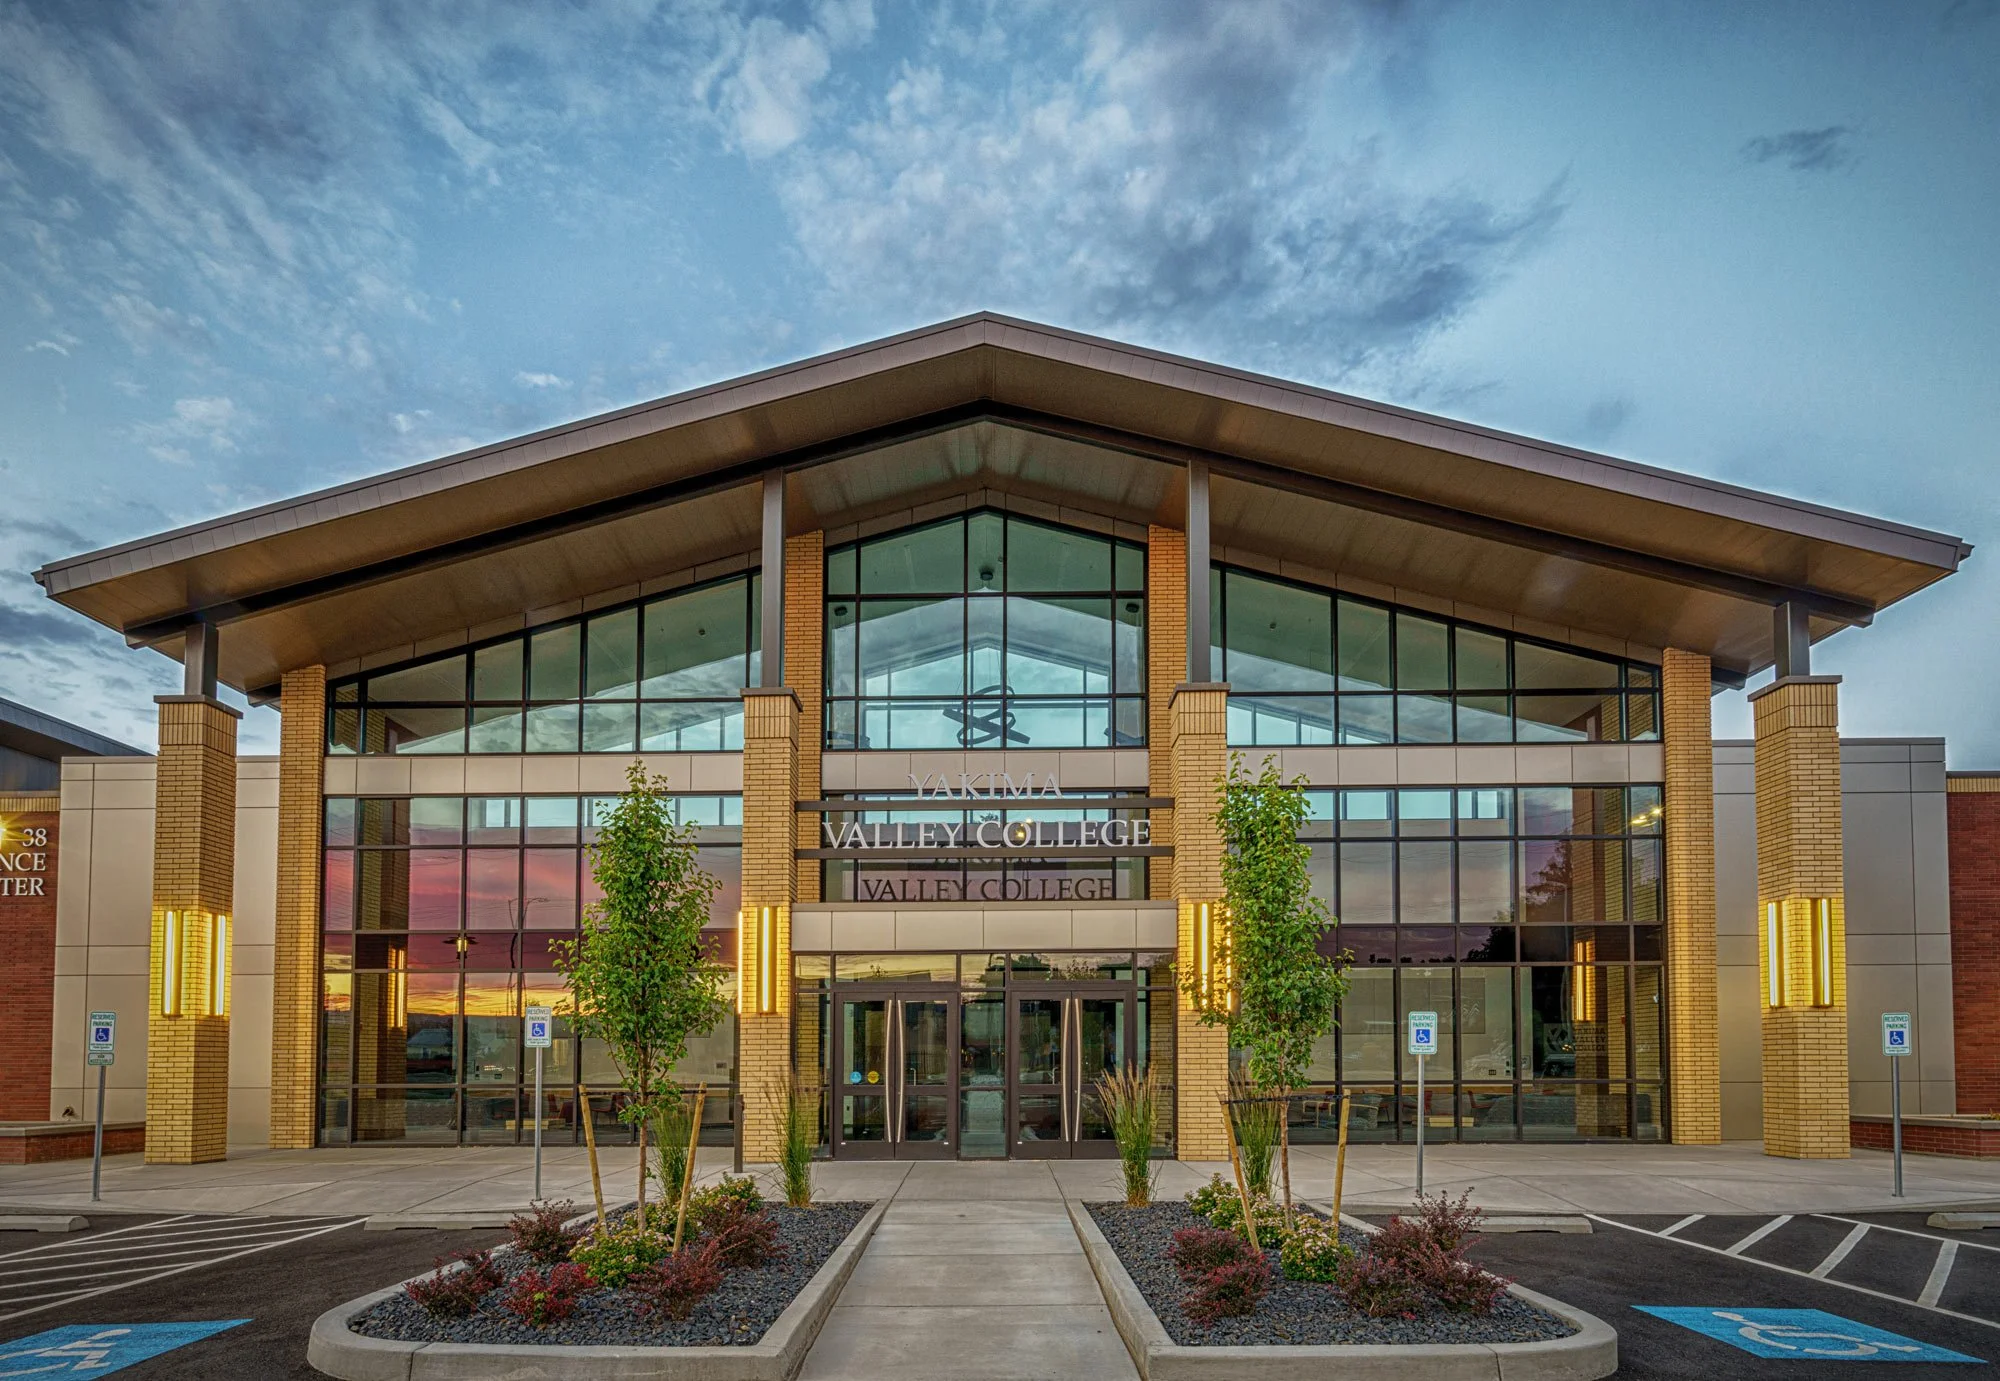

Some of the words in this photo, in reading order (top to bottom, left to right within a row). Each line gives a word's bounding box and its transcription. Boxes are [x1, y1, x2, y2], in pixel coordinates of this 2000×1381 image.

[907, 772, 1064, 800] YAKIMA
[22, 828, 47, 847] 38
[822, 821, 963, 849] VALLEY
[976, 819, 1152, 848] COLLEGE
[861, 879, 972, 901] VALLEY
[980, 878, 1114, 901] COLLEGE
